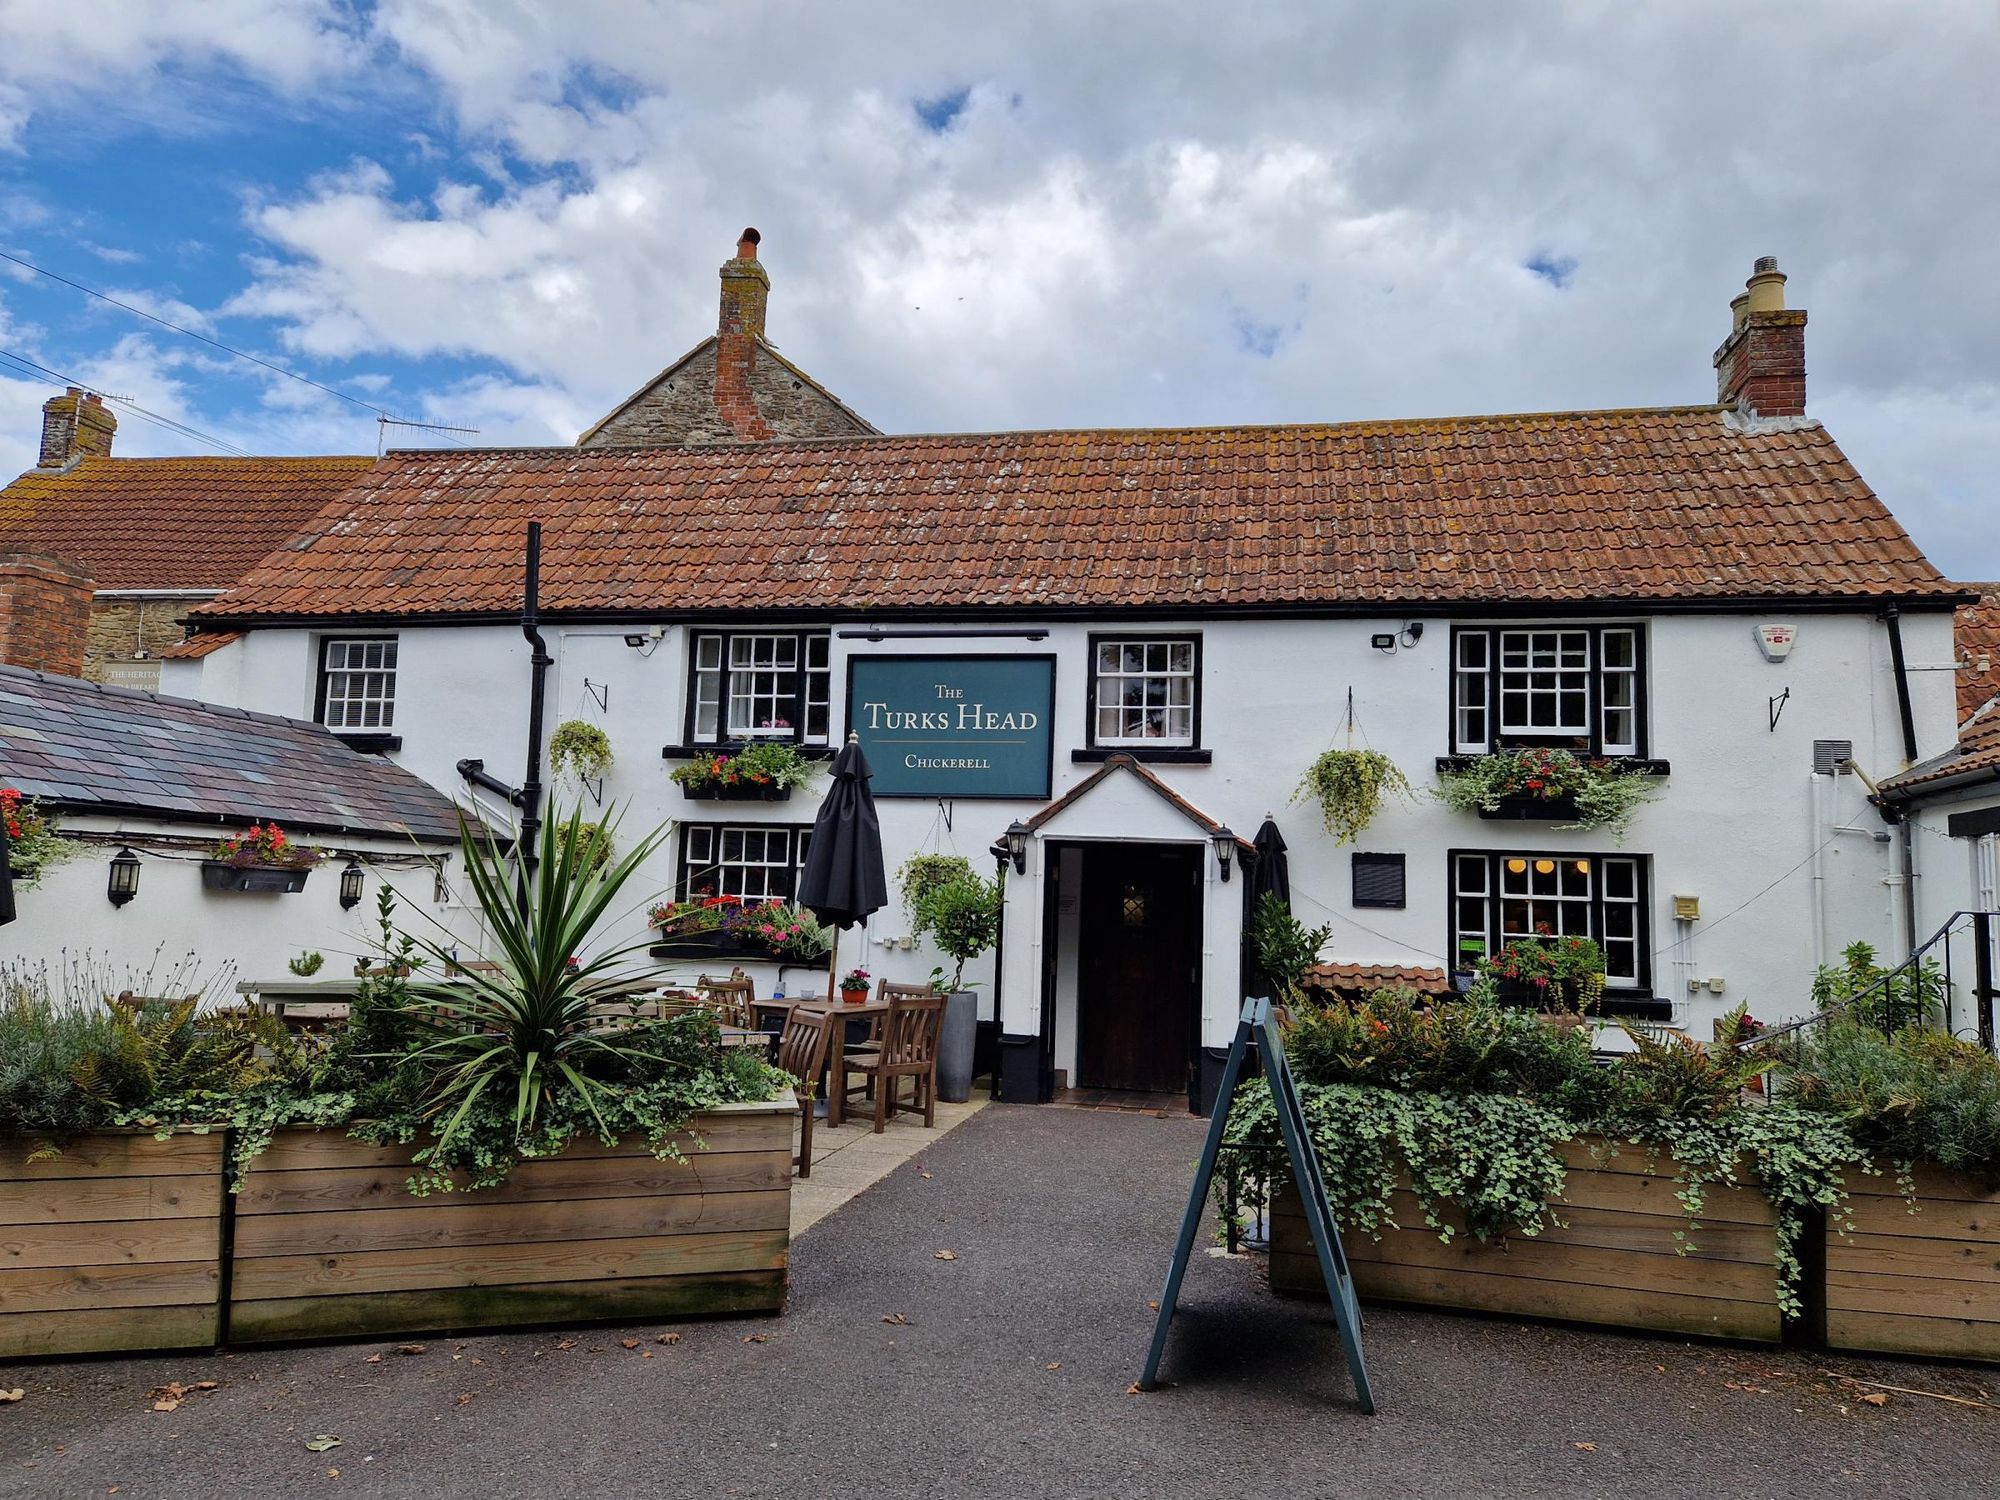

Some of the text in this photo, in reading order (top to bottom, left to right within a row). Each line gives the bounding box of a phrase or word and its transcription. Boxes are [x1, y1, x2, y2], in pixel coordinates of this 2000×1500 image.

[111, 671, 127, 679] THE
[934, 684, 964, 699] THE
[863, 702, 1038, 730] TURKS HEAD
[904, 754, 990, 769] CHICKERELL
